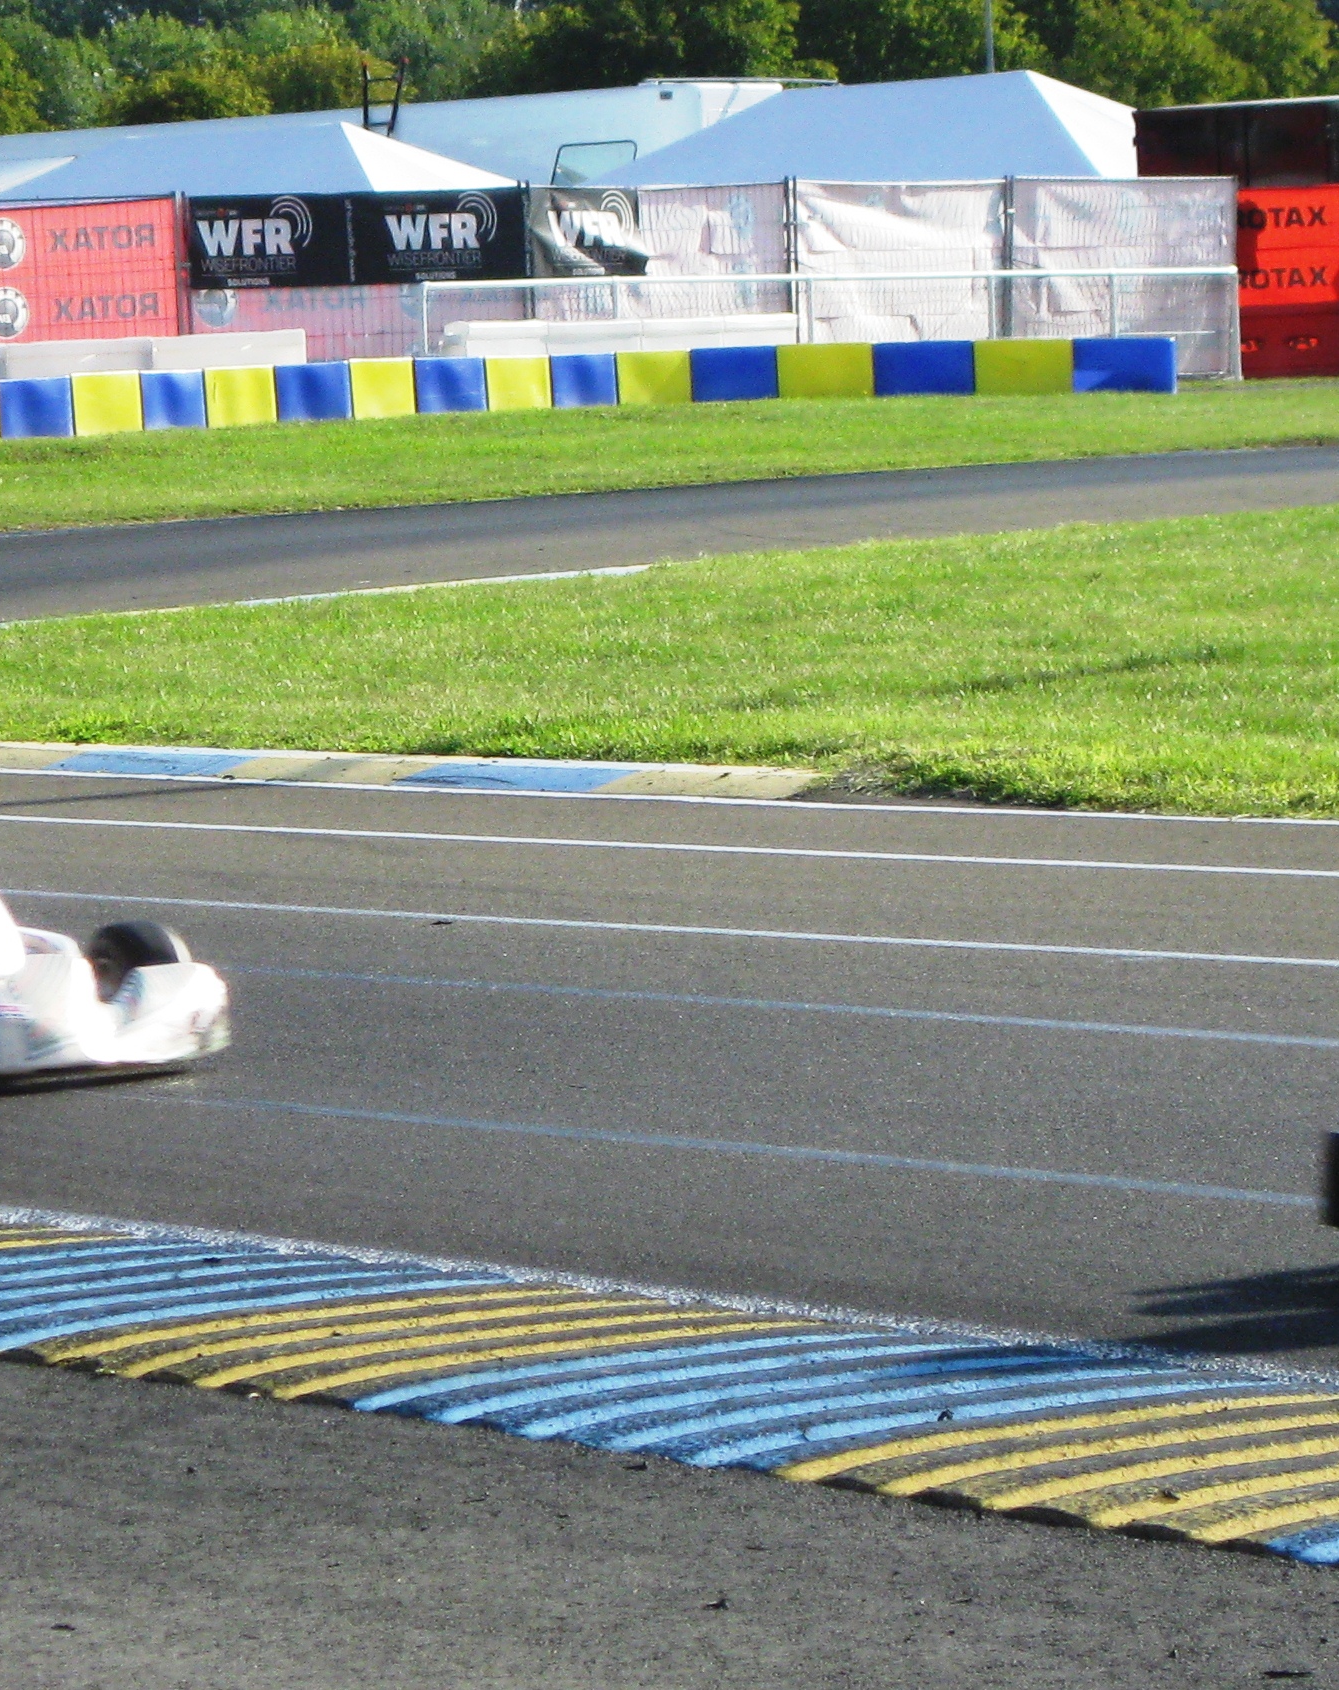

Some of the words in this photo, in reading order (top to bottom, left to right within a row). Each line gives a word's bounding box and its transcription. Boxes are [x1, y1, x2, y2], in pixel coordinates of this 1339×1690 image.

[196, 218, 295, 256] WFR
[385, 213, 480, 250] WFR
[548, 210, 625, 247] WFR
[200, 256, 296, 272] WISEFRONTIER
[227, 277, 270, 287] SOLUTIONS
